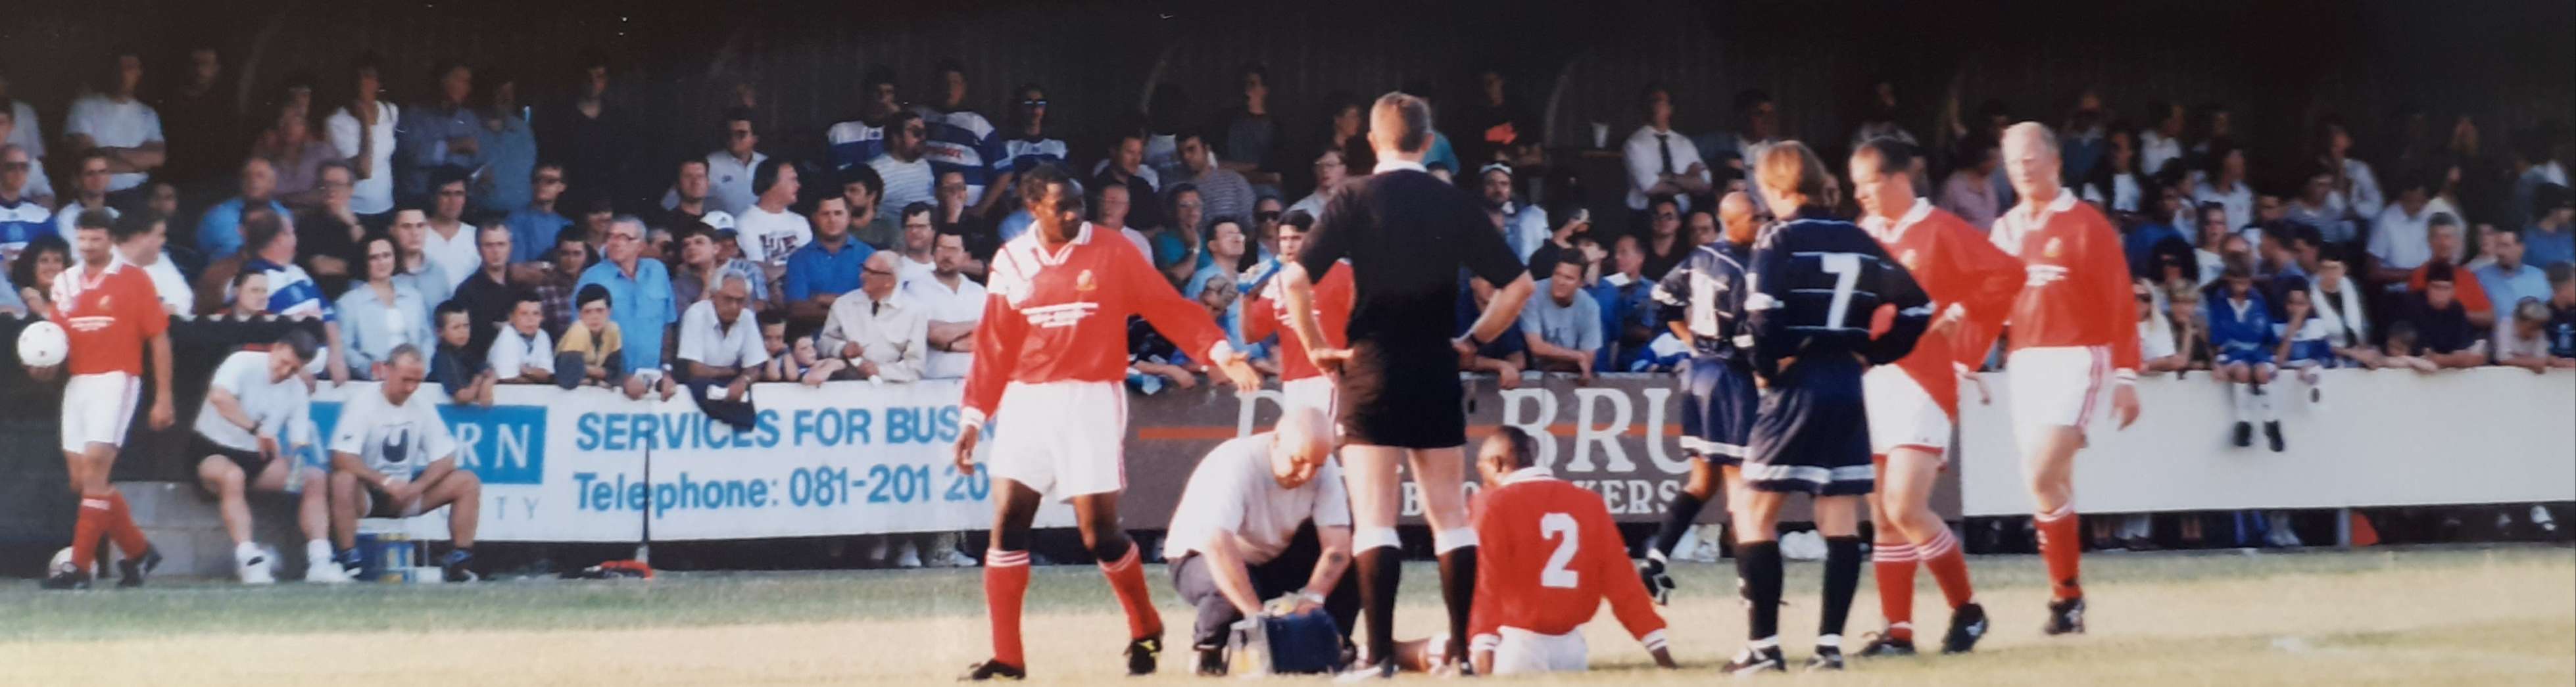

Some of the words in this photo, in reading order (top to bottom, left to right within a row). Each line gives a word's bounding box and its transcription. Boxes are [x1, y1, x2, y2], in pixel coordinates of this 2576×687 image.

[1821, 253, 1860, 329] 7
[793, 407, 871, 446] FOR
[573, 471, 779, 519] Telephone:
[790, 464, 930, 506] 081-201
[944, 462, 990, 501] 20
[1540, 513, 1579, 588] 2
